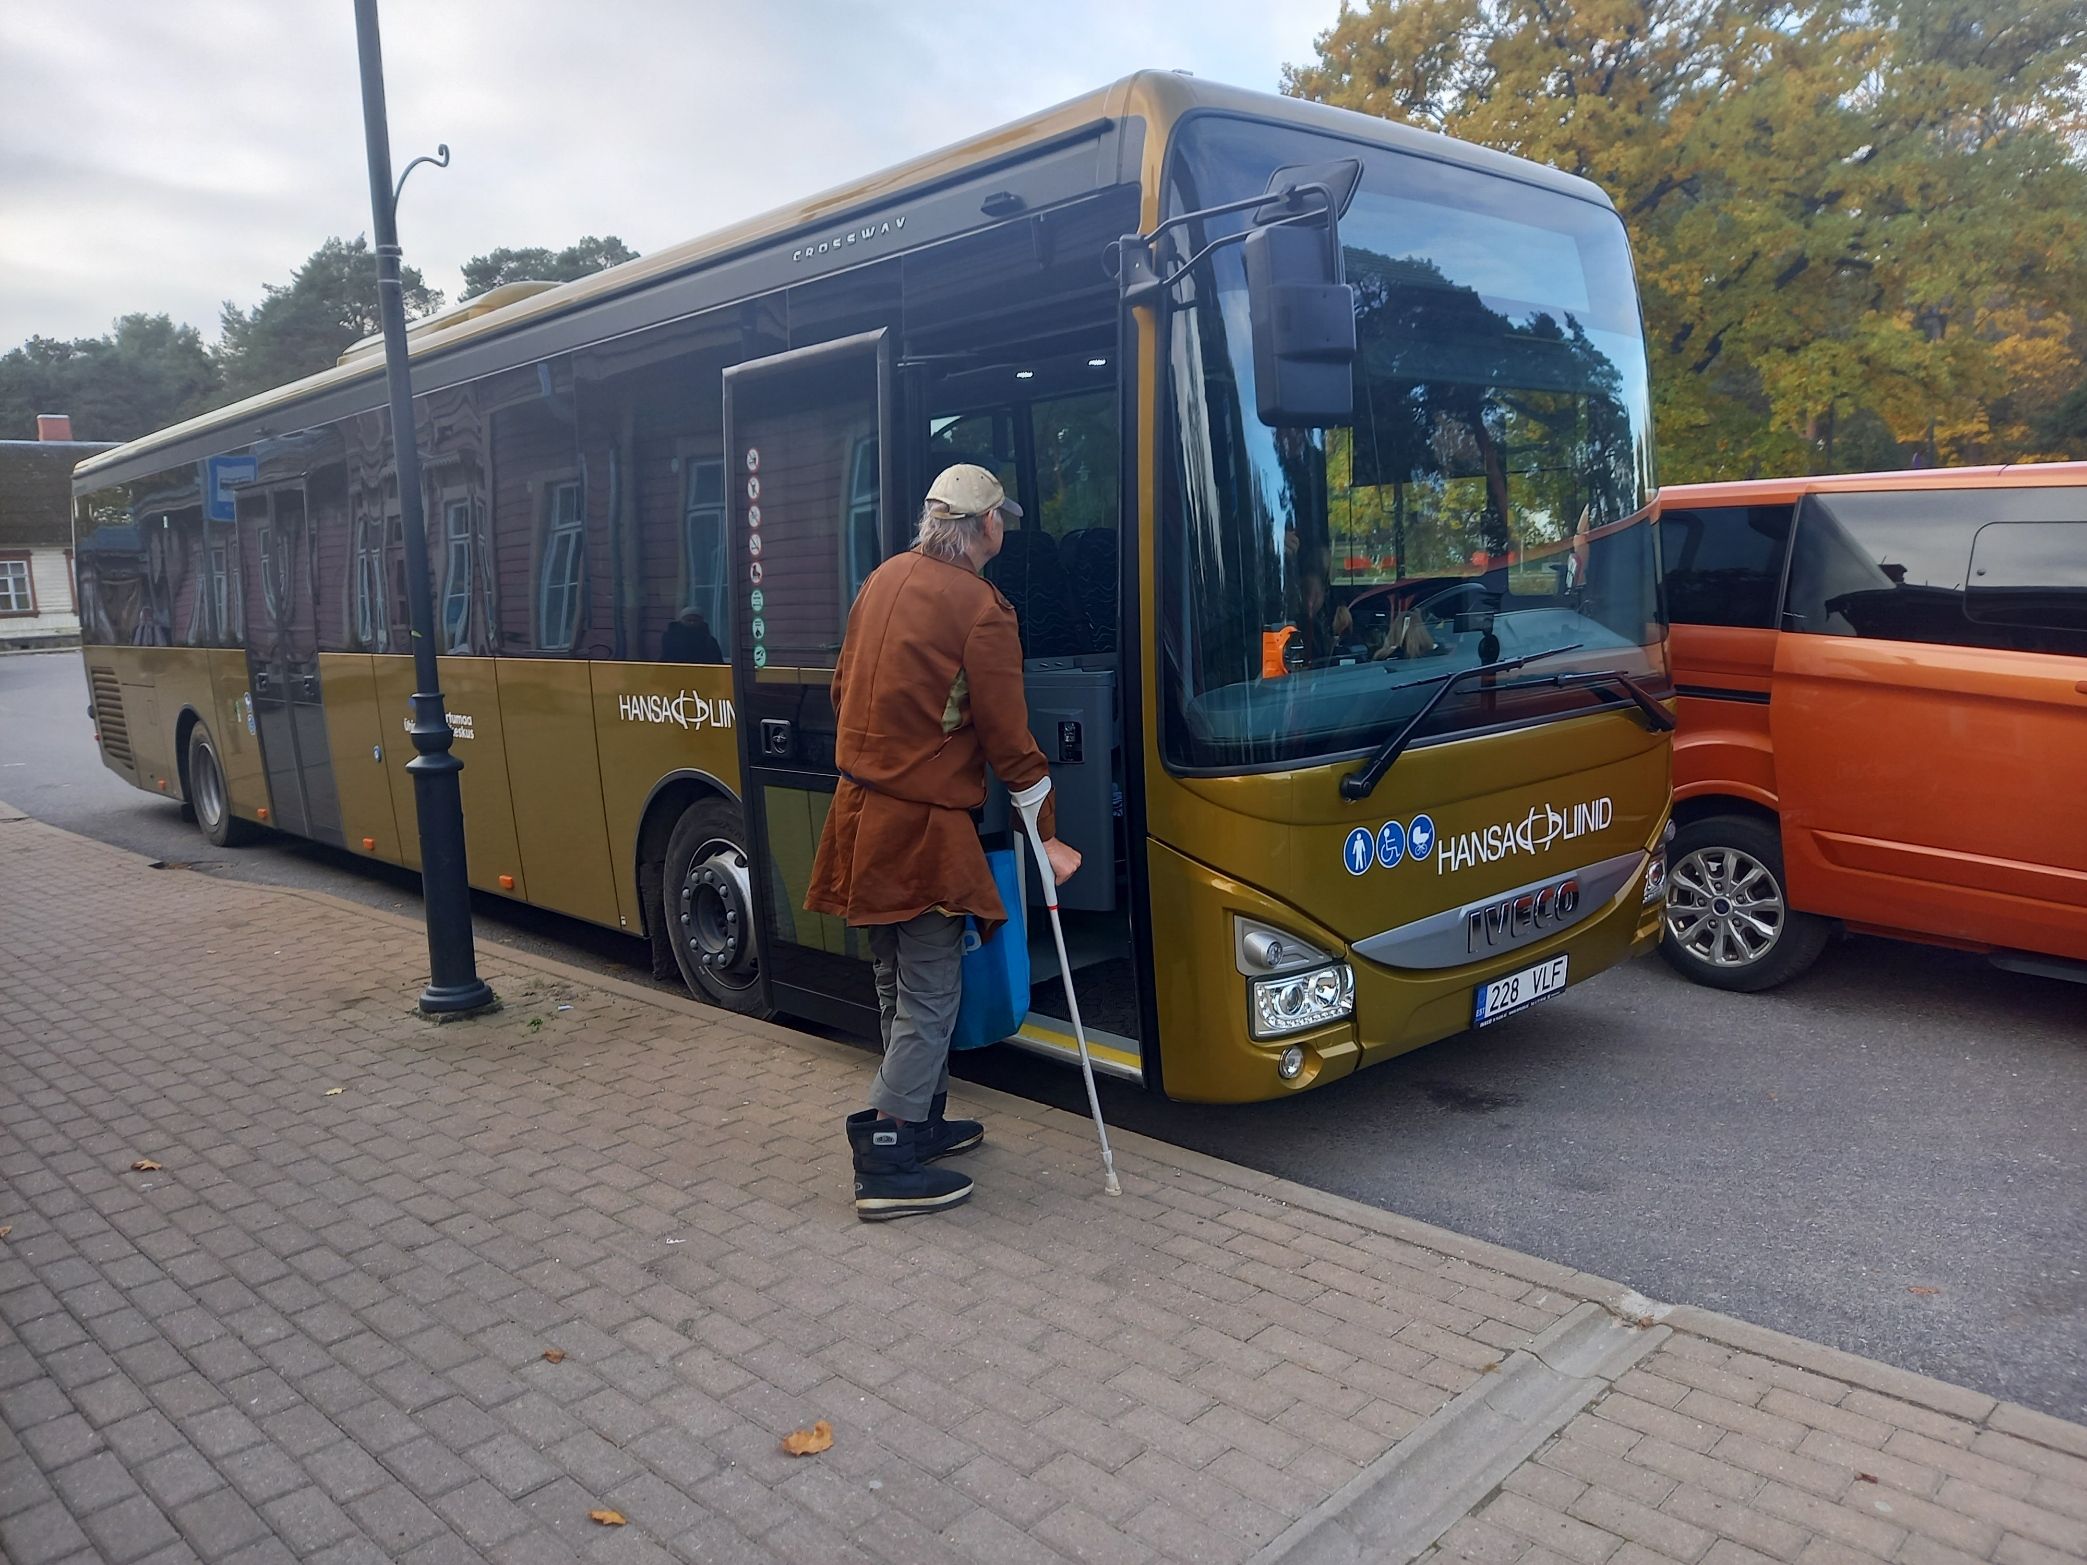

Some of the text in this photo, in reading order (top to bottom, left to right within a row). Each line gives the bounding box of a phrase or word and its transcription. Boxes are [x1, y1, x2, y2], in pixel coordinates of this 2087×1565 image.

[792, 216, 906, 261] CROSSWAY
[444, 711, 473, 726] rtumaa
[618, 694, 736, 728] HANSA LIIN
[1437, 797, 1613, 875] HANSA LIINID
[1467, 879, 1579, 954] IVECO
[1489, 977, 1520, 1013] 228
[1532, 959, 1564, 994] VLF
